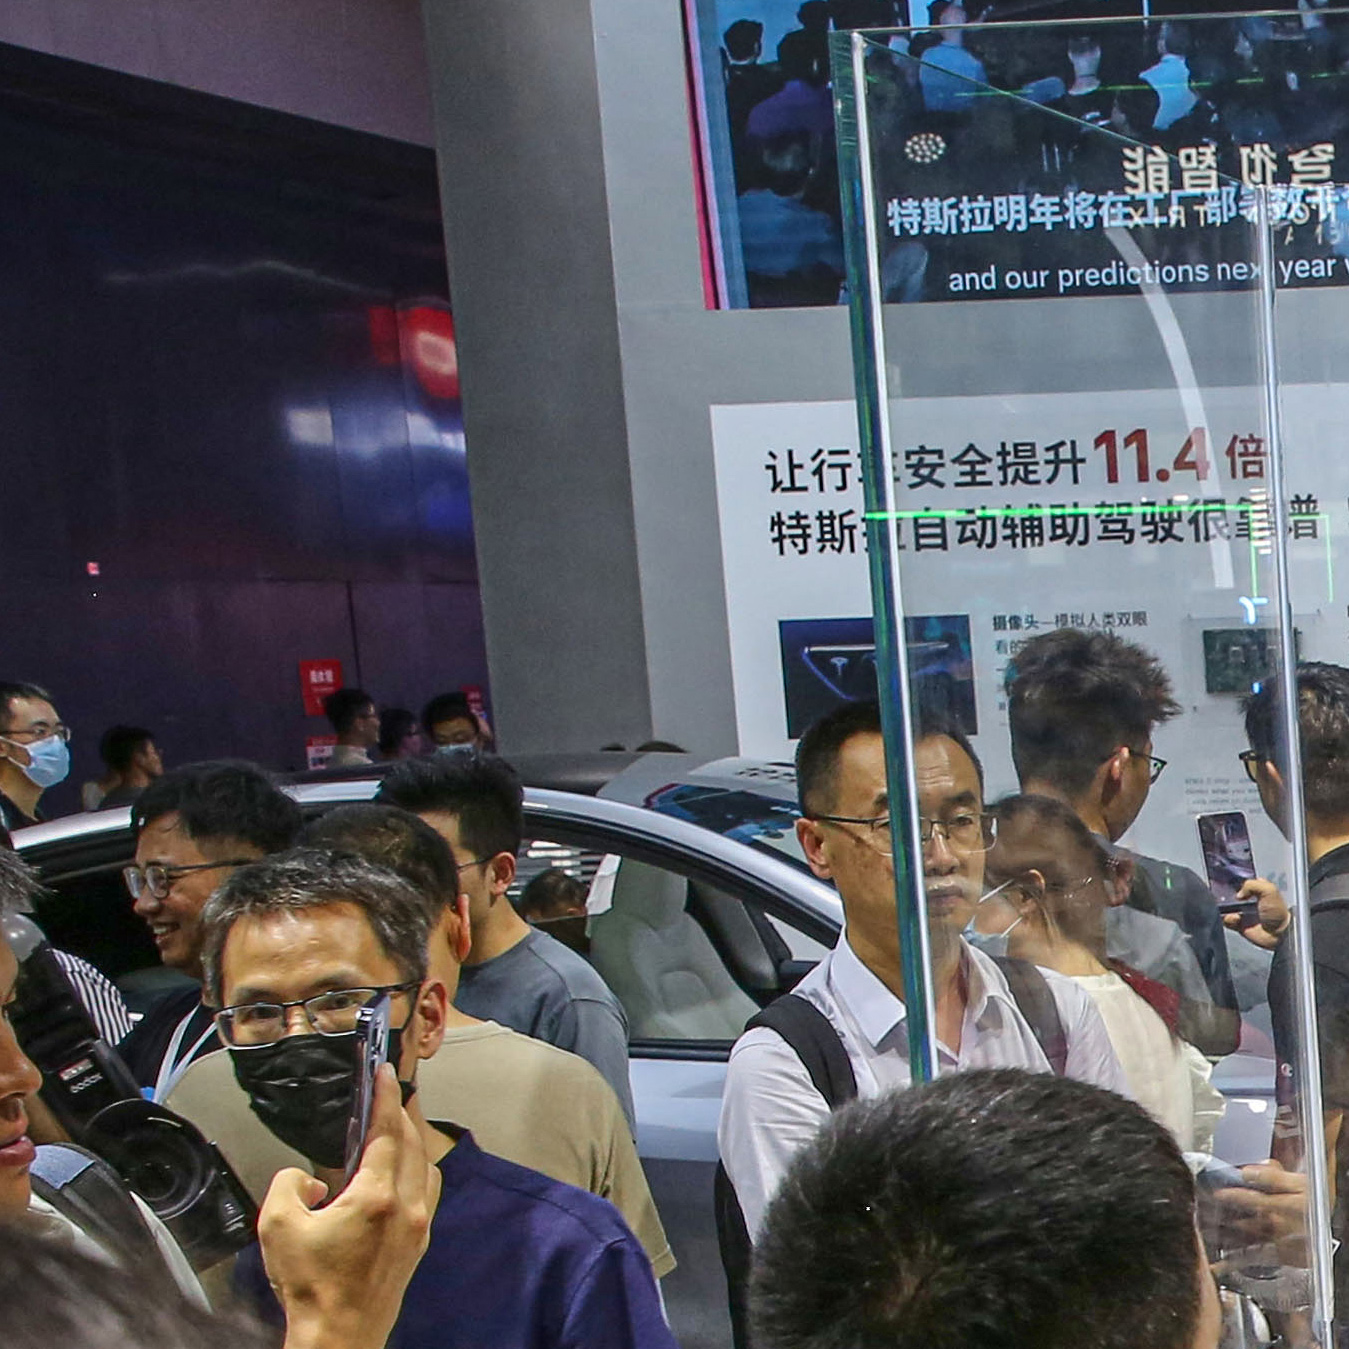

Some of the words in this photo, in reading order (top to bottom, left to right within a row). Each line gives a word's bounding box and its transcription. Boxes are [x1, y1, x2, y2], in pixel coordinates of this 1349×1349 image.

[950, 266, 995, 291] and
[1006, 271, 1050, 289] our
[1059, 259, 1209, 292] predictions
[1217, 264, 1264, 282] nex
[1279, 256, 1335, 283] year
[1094, 428, 1209, 484] 11.4
